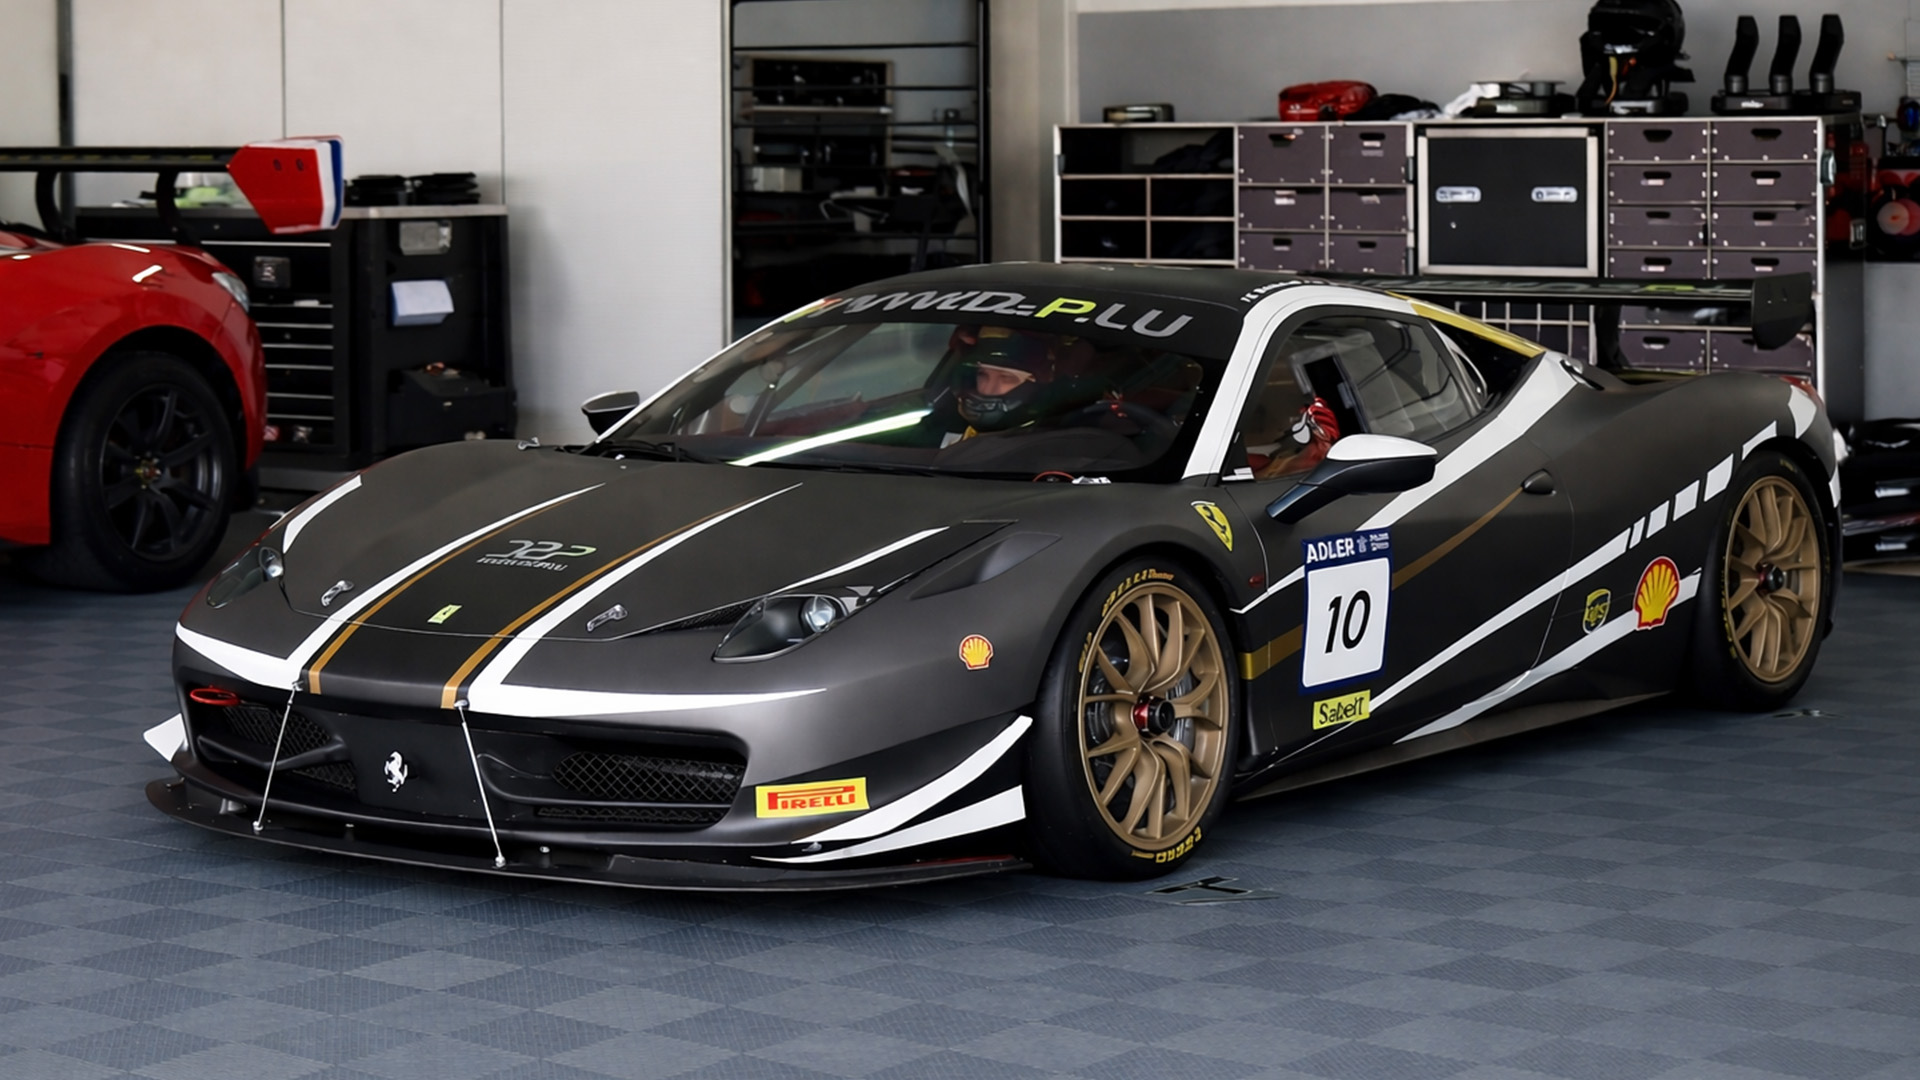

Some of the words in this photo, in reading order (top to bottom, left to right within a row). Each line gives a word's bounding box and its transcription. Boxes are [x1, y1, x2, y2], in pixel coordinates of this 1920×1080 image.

[1306, 537, 1356, 563] ADLER
[1324, 590, 1371, 655] 10
[767, 785, 856, 811] PIRELLI
